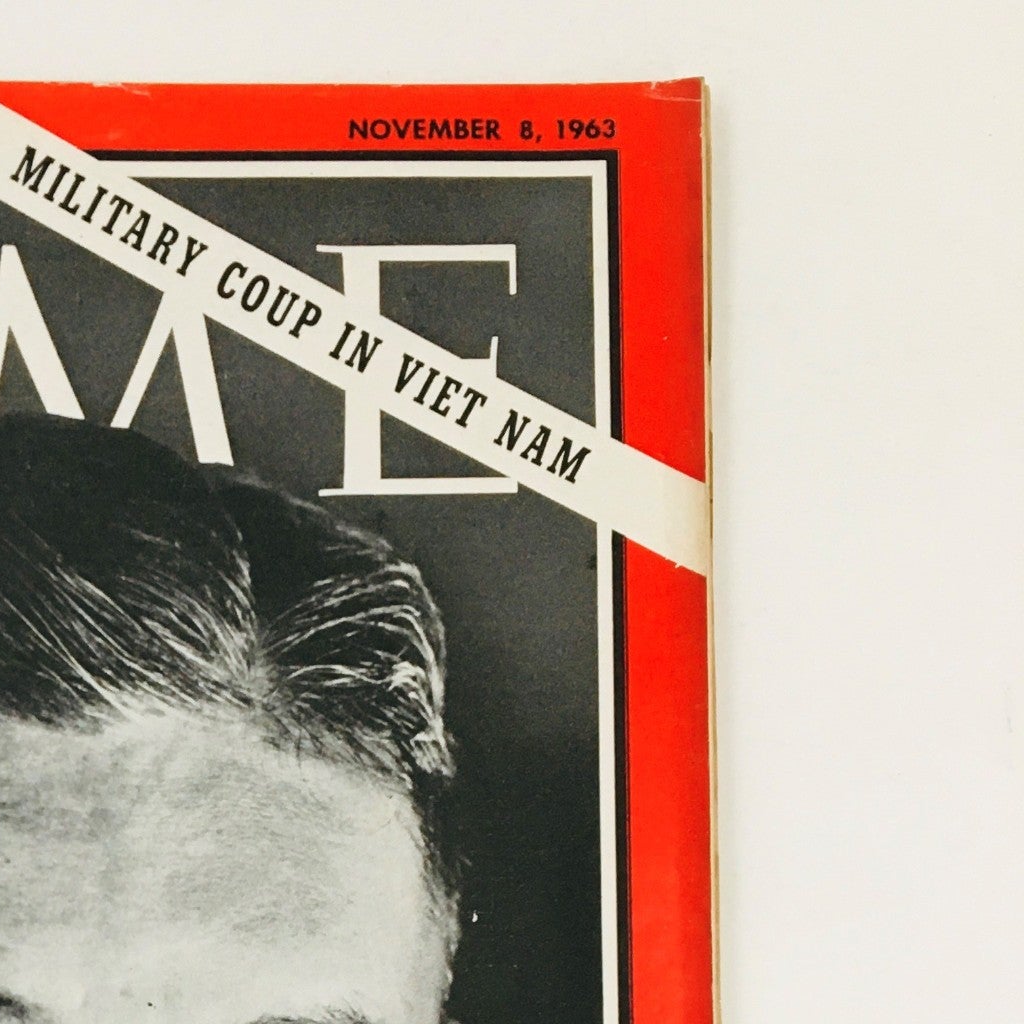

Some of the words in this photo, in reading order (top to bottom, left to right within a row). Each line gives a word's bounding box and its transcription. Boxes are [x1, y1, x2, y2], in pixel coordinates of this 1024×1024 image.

[347, 118, 501, 140] NOVEMBER
[519, 119, 543, 143] 8,
[556, 118, 616, 139] 1963
[9, 145, 209, 278] MILITARY
[216, 260, 323, 339] COUP
[328, 321, 383, 374] IN
[392, 355, 488, 430] VIET
[492, 409, 592, 485] NAM
